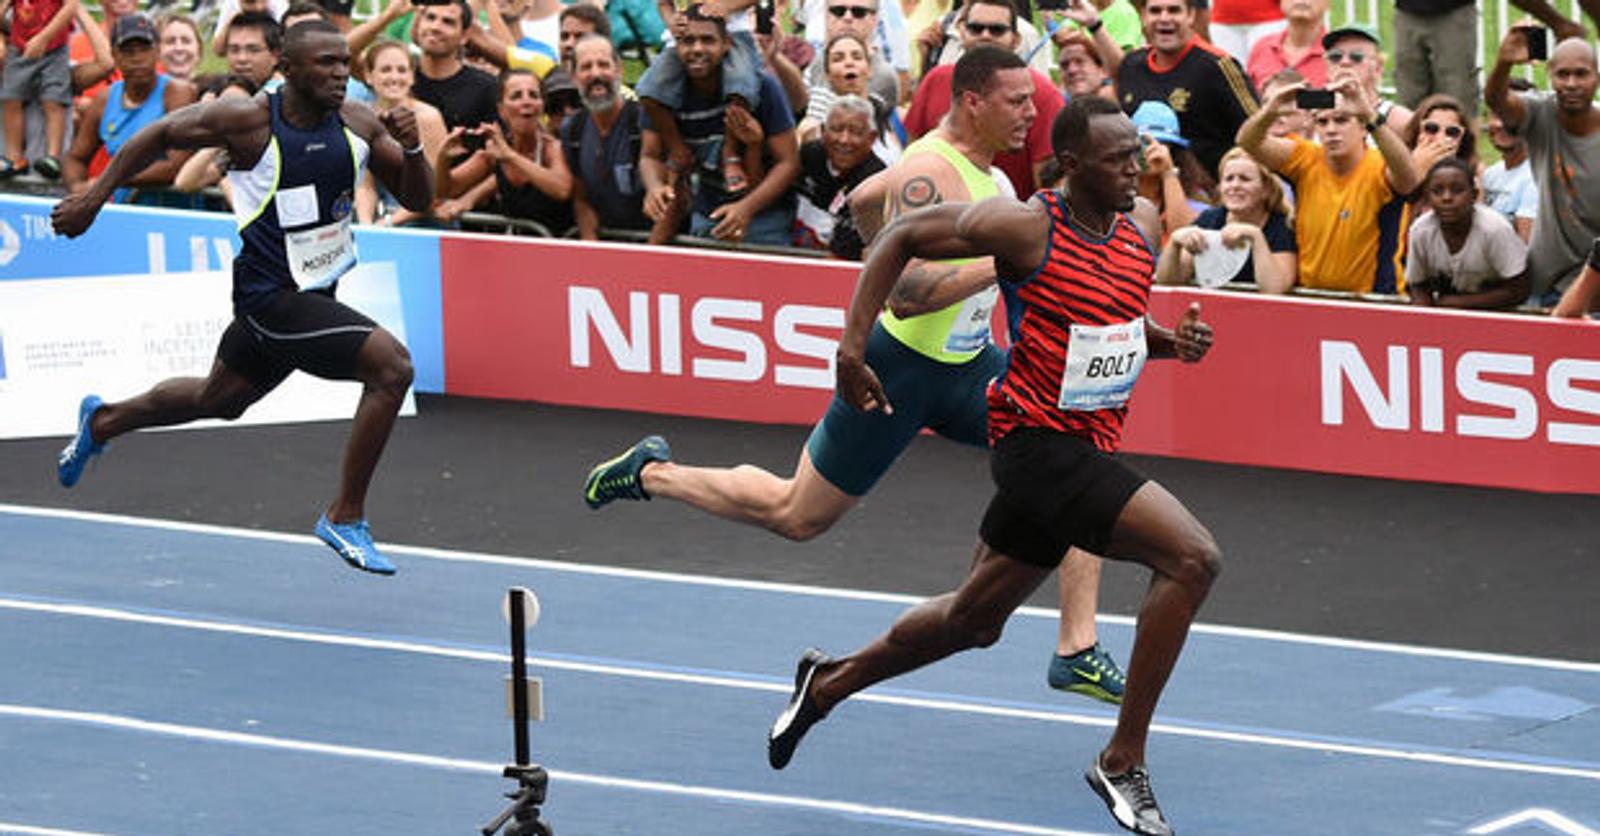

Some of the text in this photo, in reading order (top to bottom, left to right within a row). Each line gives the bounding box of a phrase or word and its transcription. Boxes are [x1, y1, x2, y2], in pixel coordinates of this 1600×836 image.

[568, 286, 846, 389] NISS
[1086, 351, 1136, 378] BOLT
[1320, 340, 1600, 446] NISS
